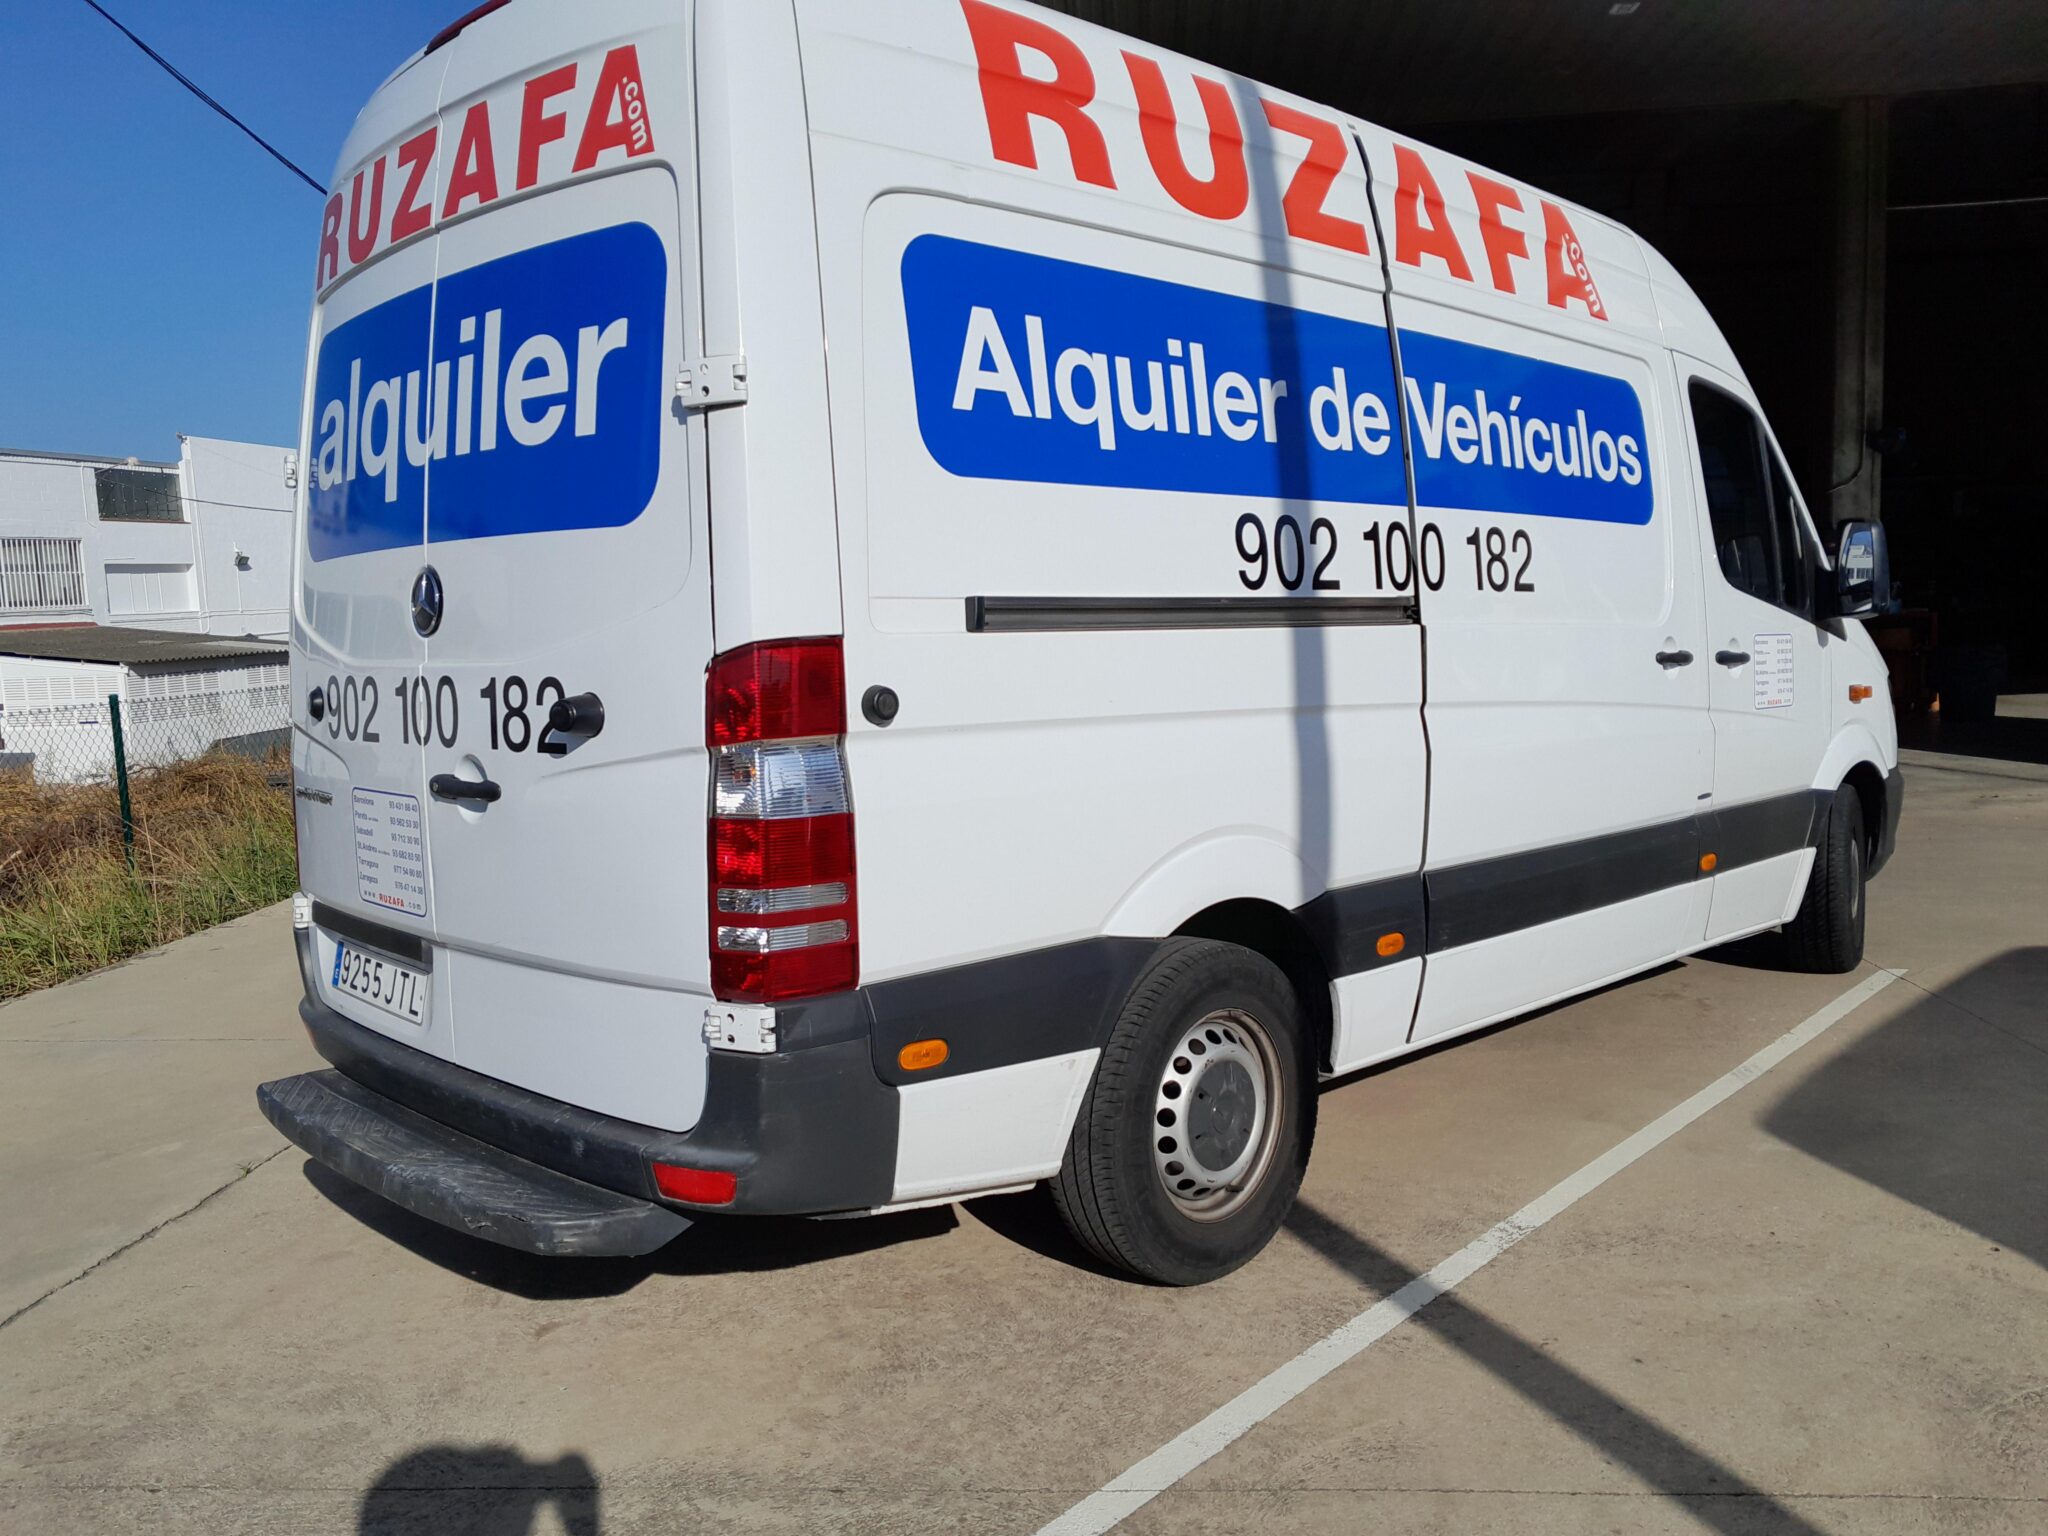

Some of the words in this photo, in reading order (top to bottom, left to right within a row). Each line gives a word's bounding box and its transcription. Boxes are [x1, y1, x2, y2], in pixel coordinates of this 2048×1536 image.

[622, 76, 648, 151] .com
[316, 44, 655, 291] RUZAFA
[960, 0, 1608, 321] RUZAFA
[1564, 232, 1601, 313] .com
[318, 308, 629, 503] alquiler
[953, 306, 1288, 450] Alquiler
[1309, 367, 1391, 456] de
[1404, 377, 1643, 486] Vehículos
[1235, 513, 1341, 591] 902
[1362, 521, 1446, 592] 100
[1466, 527, 1535, 593] 182
[327, 675, 380, 743] 902
[395, 675, 459, 749] 100
[480, 675, 568, 754] 182
[353, 794, 375, 806] Barcelona
[378, 893, 405, 908] RUZAFA
[341, 949, 384, 999] 9255
[384, 968, 419, 1017] JTL
